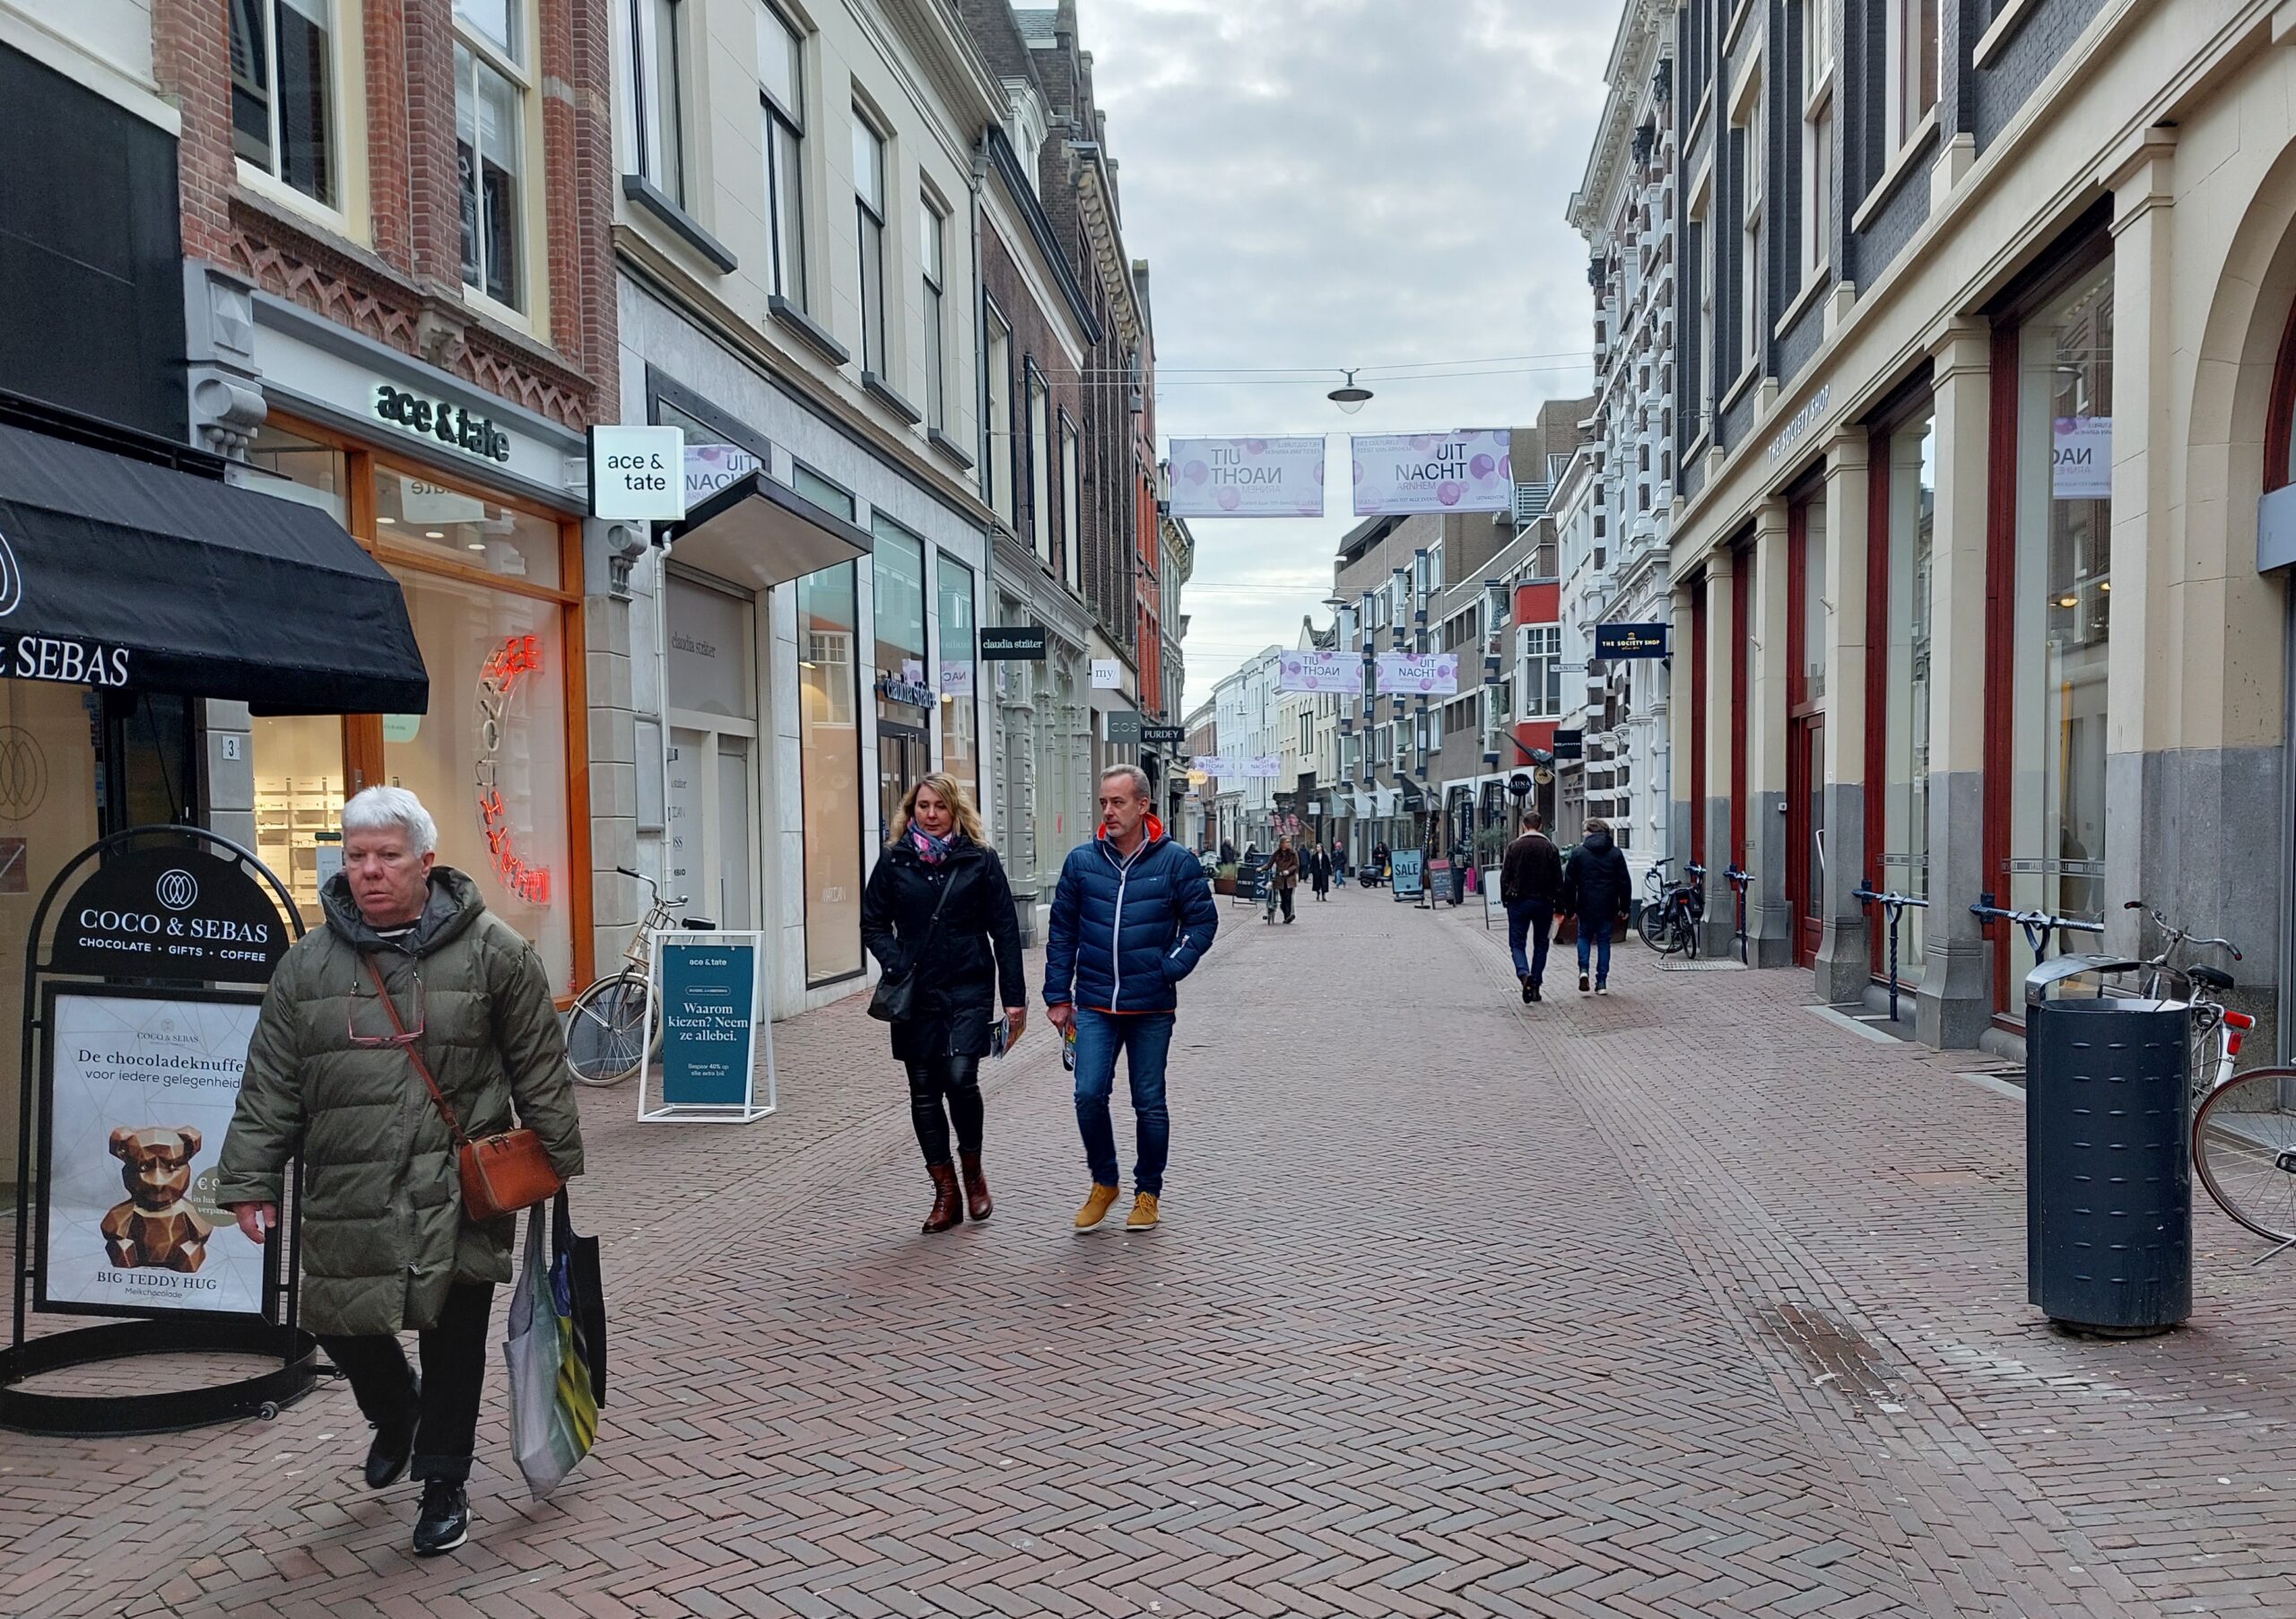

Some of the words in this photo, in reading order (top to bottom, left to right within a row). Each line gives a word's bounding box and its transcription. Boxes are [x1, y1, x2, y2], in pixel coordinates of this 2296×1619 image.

[377, 386, 432, 432] ace
[435, 403, 457, 444] &
[457, 408, 509, 462] tate
[1768, 436, 1780, 466] THE
[1782, 403, 1811, 452] SOCIETY
[1811, 383, 1830, 422] SHOP
[1437, 443, 1467, 461] UIT
[608, 455, 645, 469] ace
[650, 453, 664, 469] &
[726, 455, 754, 471] UIT
[1396, 462, 1467, 481] NACHT
[624, 473, 665, 491] tate
[686, 473, 745, 491] NAC
[1396, 482, 1436, 491] ARNHEM
[983, 639, 1013, 648] claudia
[1014, 639, 1043, 648] sträter
[16, 636, 130, 687] SEBAS
[1421, 658, 1436, 668] UIT
[1095, 669, 1114, 681] my
[1398, 667, 1436, 678] NACHT
[1110, 722, 1139, 733] COS
[1144, 730, 1180, 739] PURDEY
[228, 740, 235, 756] 3
[1396, 862, 1419, 876] SALE
[1256, 873, 1265, 895] SAL
[80, 909, 161, 934] COCO
[166, 917, 185, 937] &
[190, 918, 268, 944] SEBAS
[79, 937, 152, 952] CHOCOLATE
[169, 945, 203, 957] GIFTS
[220, 950, 266, 962] COFFEE
[711, 958, 727, 966] tate
[683, 1002, 734, 1014] Waarom
[668, 1015, 711, 1028] kiezen?
[715, 1016, 749, 1028] Neem
[137, 1032, 164, 1041] COCO
[172, 1035, 199, 1043] SEBAS
[679, 1031, 692, 1041] ze
[695, 1030, 737, 1041] allebei.
[78, 1049, 101, 1063] De
[106, 1051, 245, 1073] chocoladeknuffe
[85, 1070, 115, 1080] voor
[118, 1069, 160, 1083] iedere
[163, 1075, 240, 1089] gelegenheid
[197, 1177, 207, 1190] €
[203, 1195, 215, 1203] lux
[98, 1272, 123, 1284] BIG
[127, 1273, 179, 1287] TEDDY
[183, 1277, 217, 1290] HUG
[125, 1287, 183, 1299] Melkchocolade
